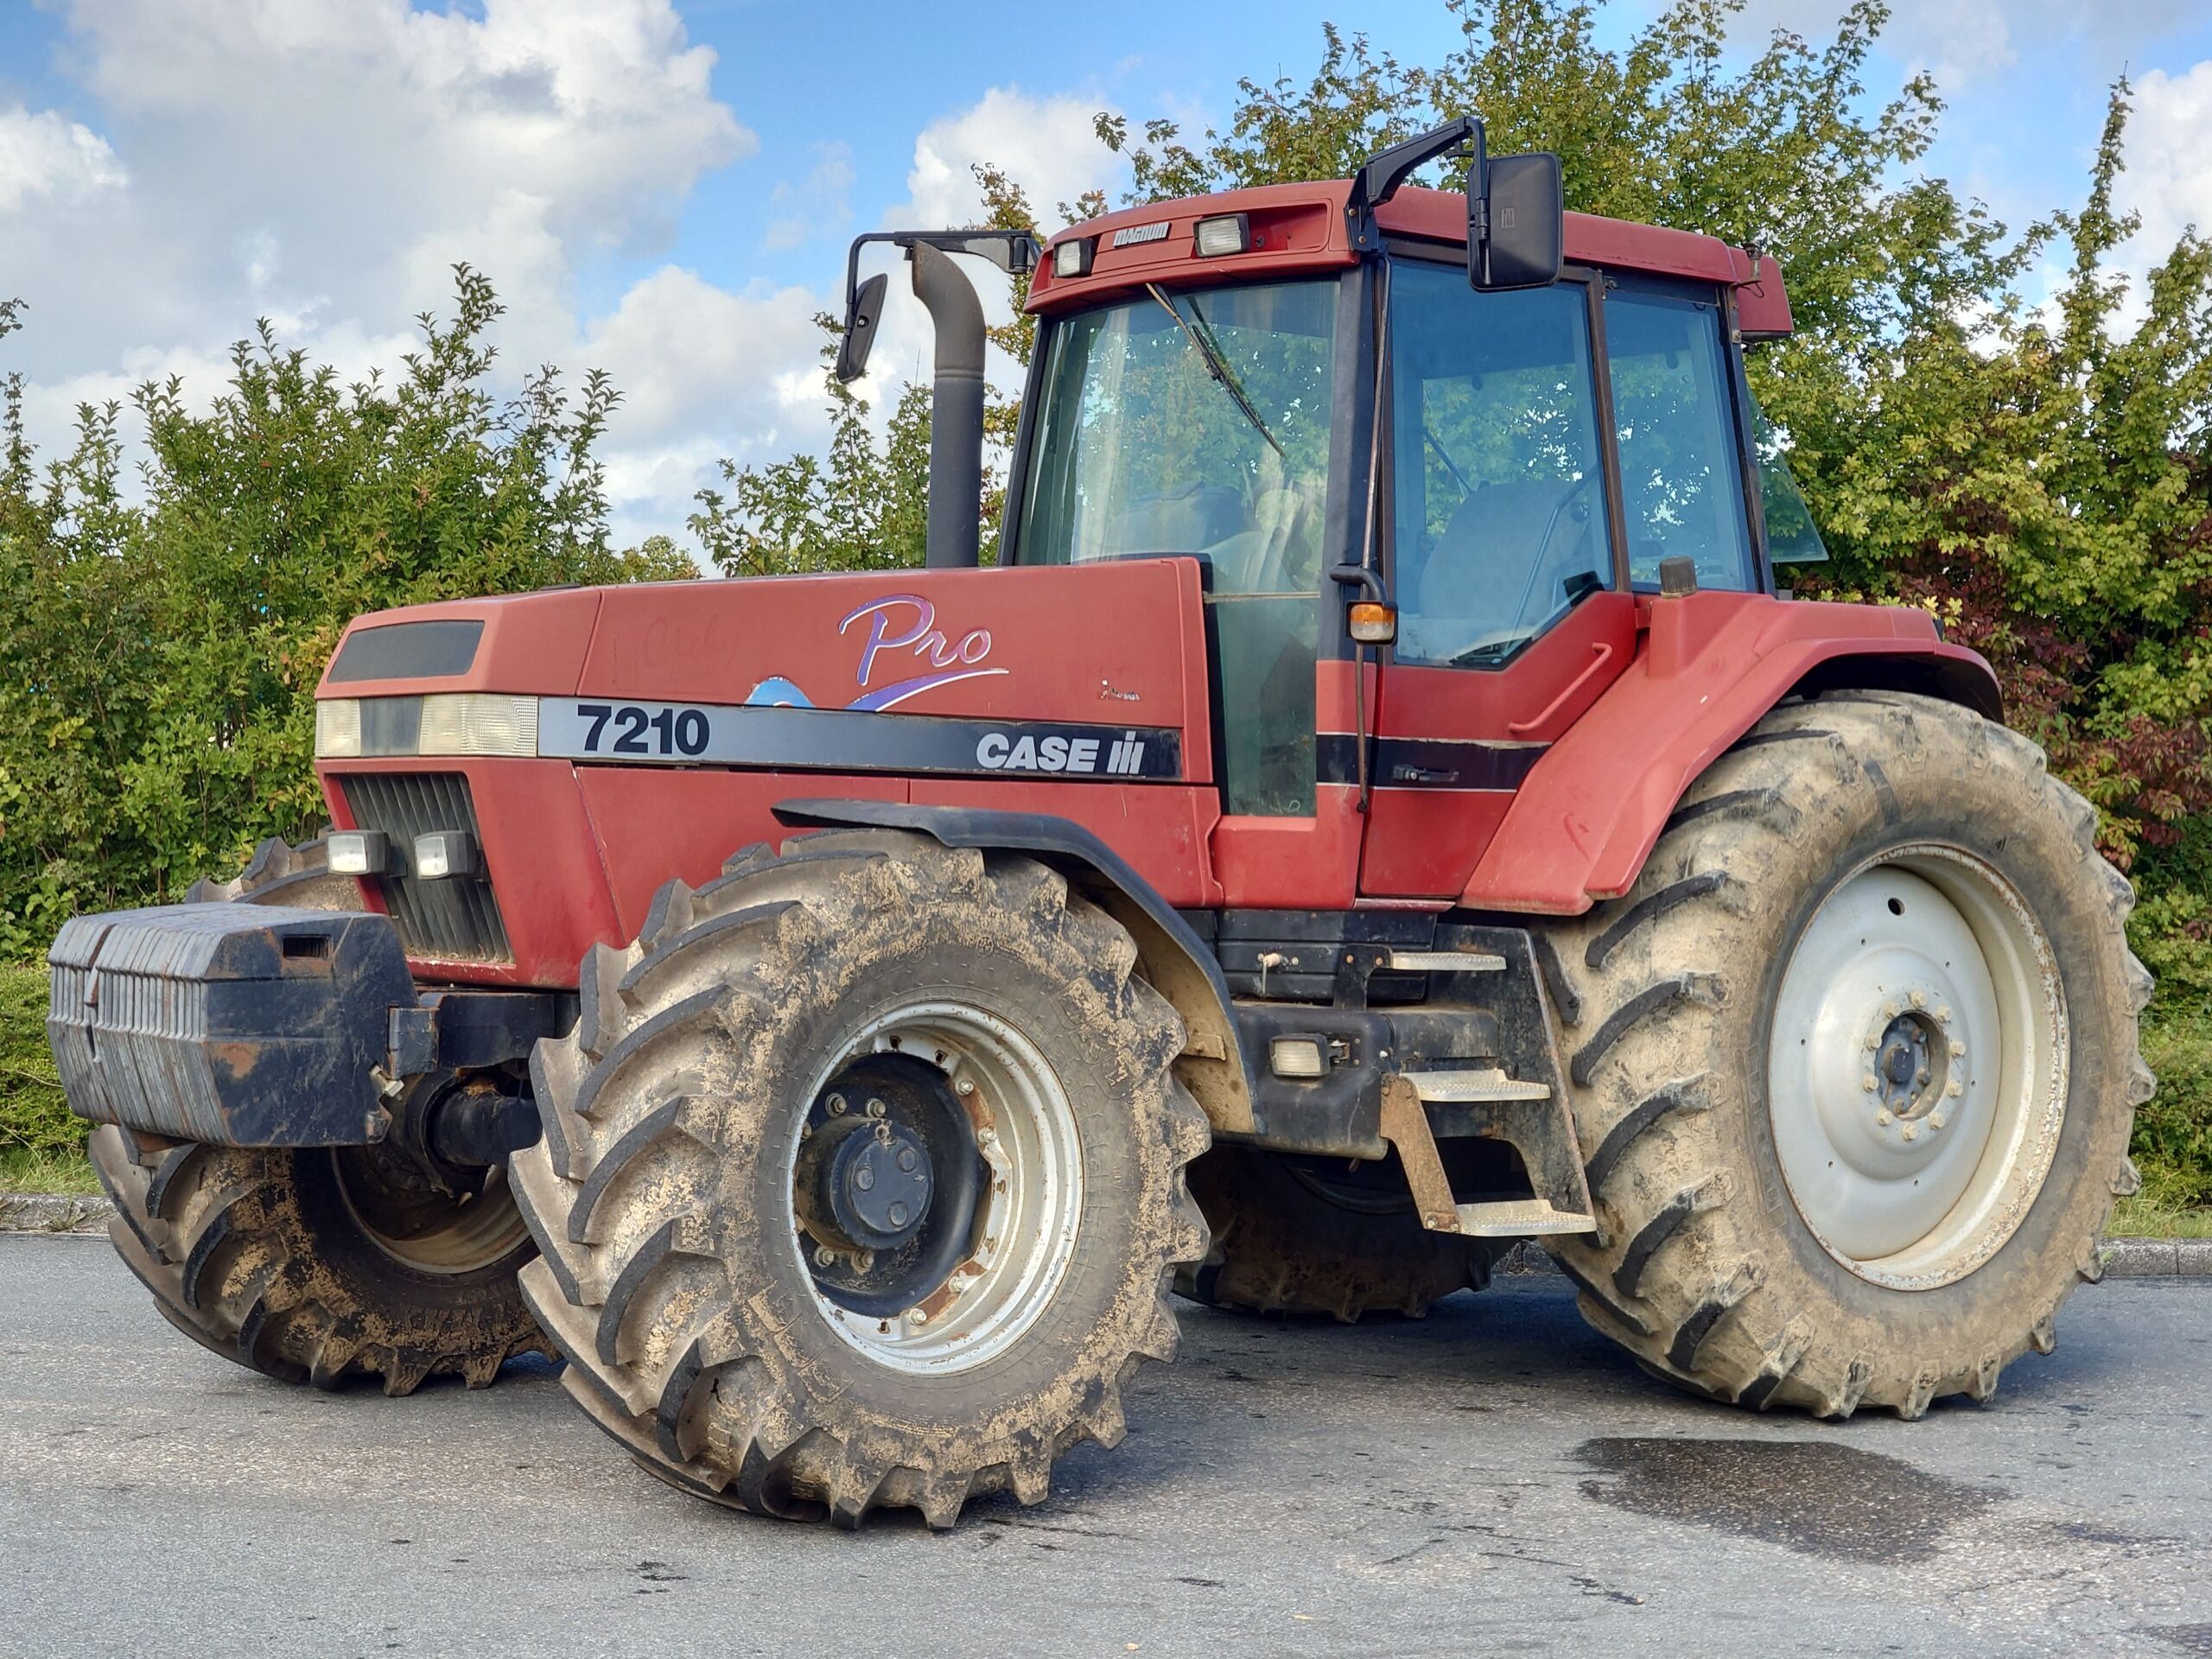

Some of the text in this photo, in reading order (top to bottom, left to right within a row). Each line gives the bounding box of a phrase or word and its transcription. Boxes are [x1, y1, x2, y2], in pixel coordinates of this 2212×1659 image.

[1112, 221, 1170, 246] MAGNUM
[838, 594, 992, 686] Pro
[577, 704, 710, 755] 7210
[976, 733, 1100, 772] CASE
